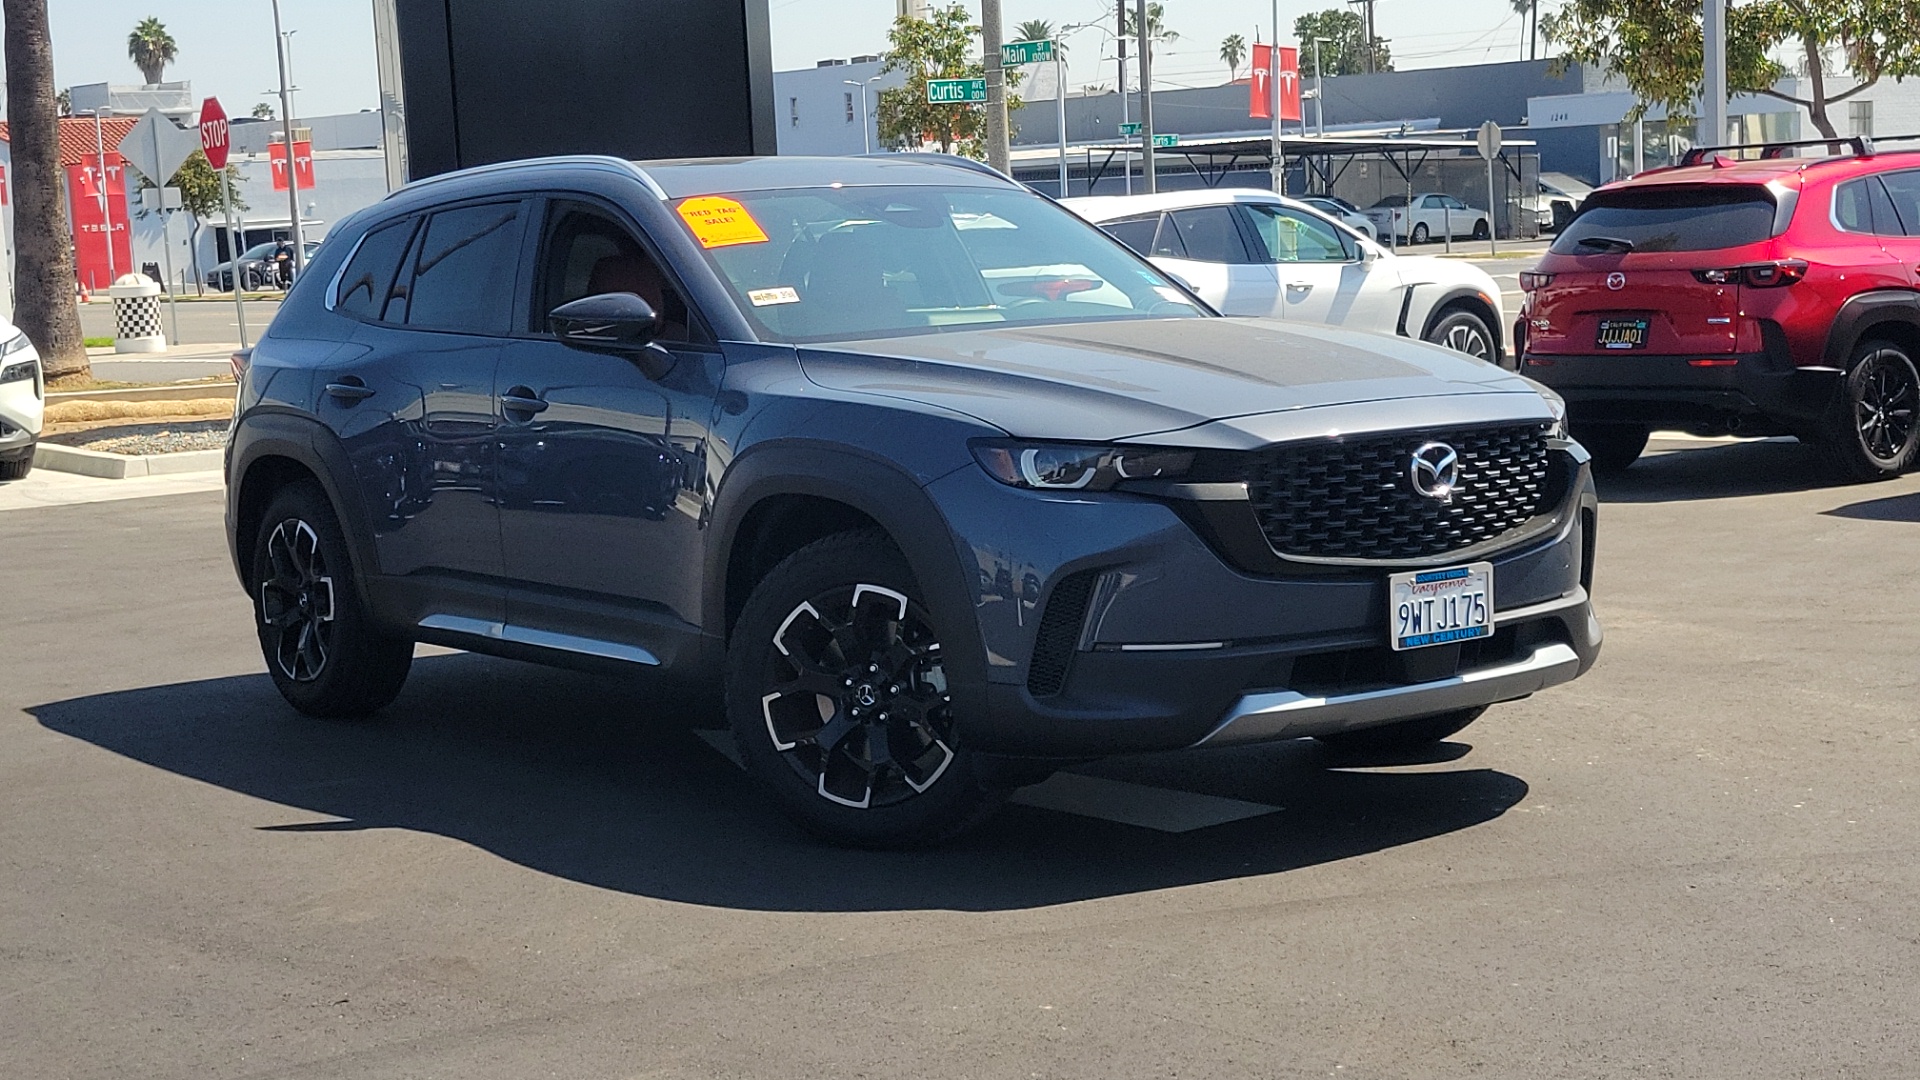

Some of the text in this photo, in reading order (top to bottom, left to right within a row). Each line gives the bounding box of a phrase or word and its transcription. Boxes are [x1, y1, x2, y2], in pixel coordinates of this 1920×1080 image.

[1002, 46, 1026, 64] Main
[1036, 42, 1044, 51] ST
[929, 82, 964, 100] Curtis
[971, 80, 983, 89] AVE
[201, 119, 227, 150] STOP
[704, 217, 736, 225] SALE!
[1399, 592, 1485, 635] 9WTJ175
[1405, 626, 1482, 647] NEW CENTURY
